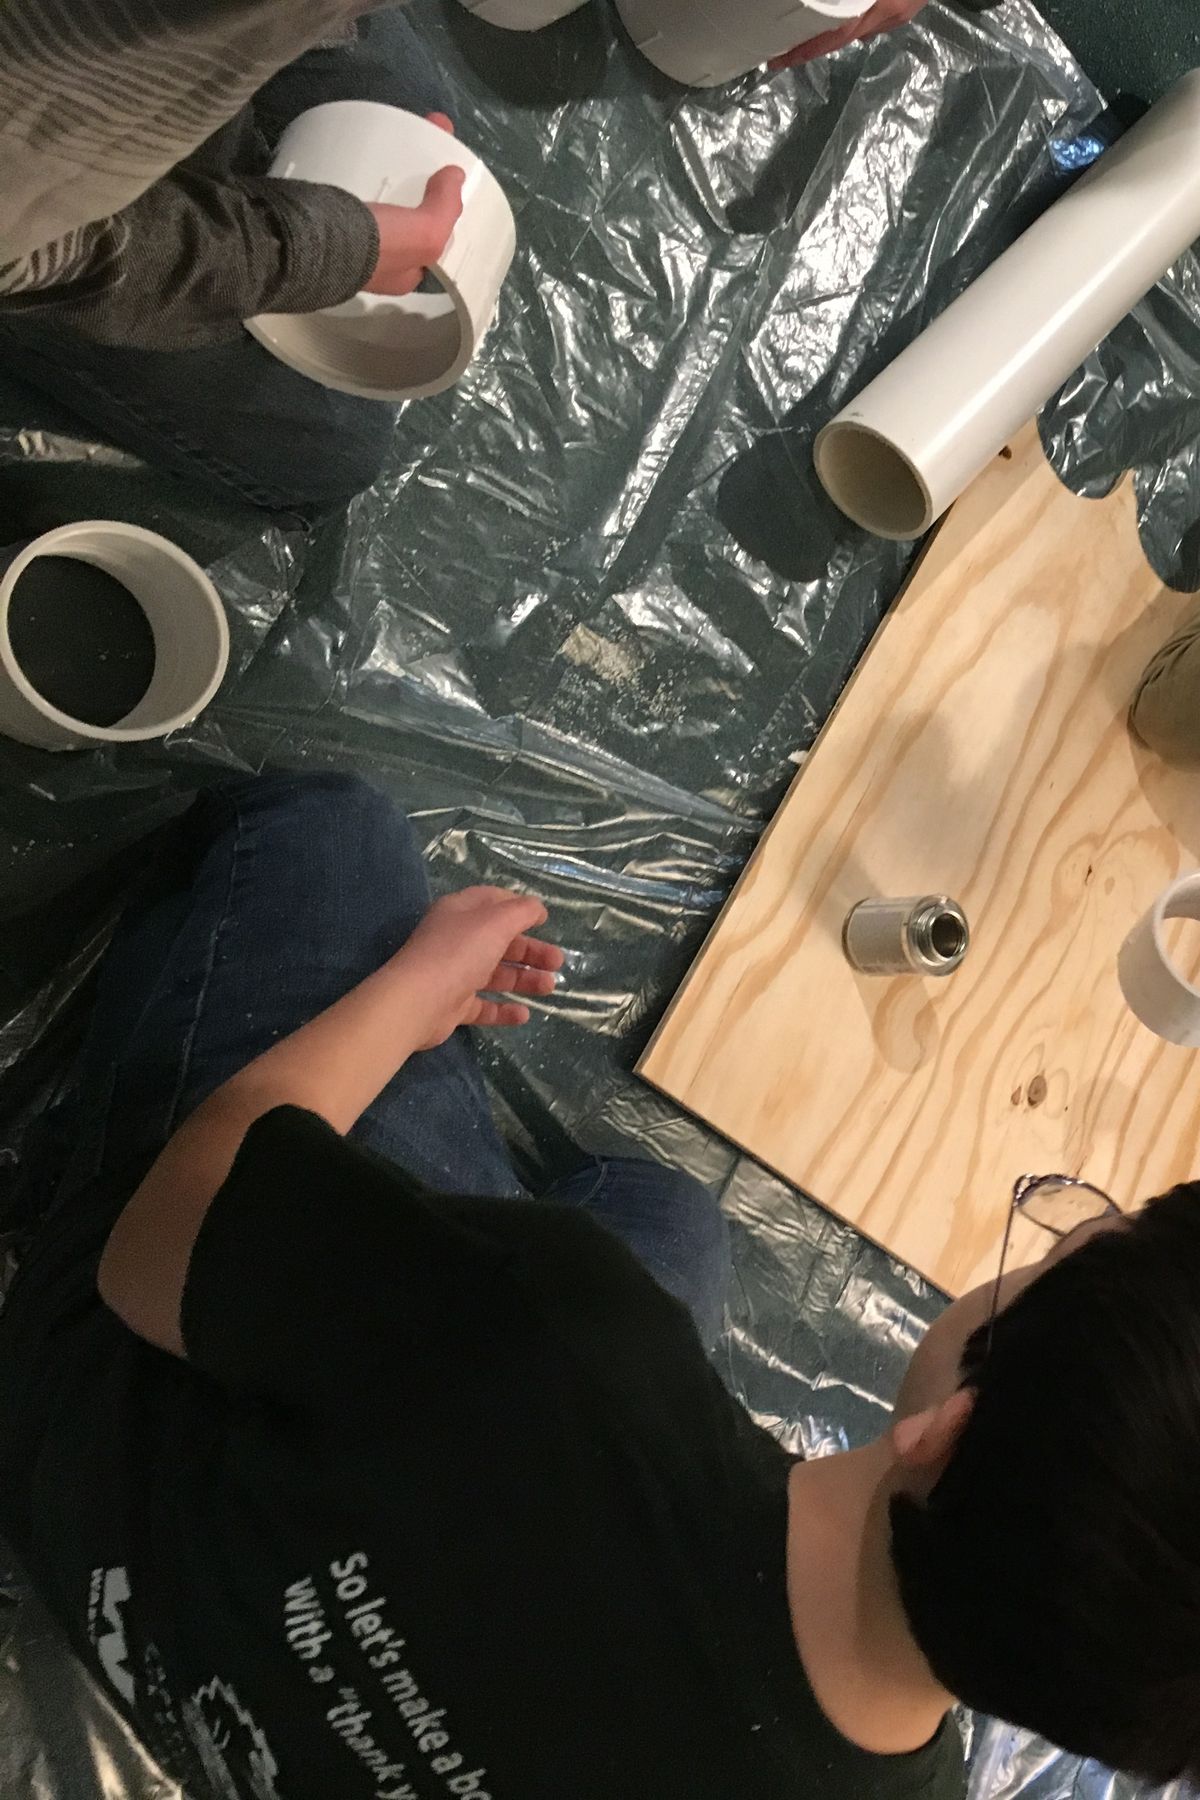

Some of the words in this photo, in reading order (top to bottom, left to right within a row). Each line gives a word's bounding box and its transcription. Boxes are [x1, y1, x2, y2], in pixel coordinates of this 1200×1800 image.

[330, 1552, 368, 1601] So
[345, 1597, 406, 1668] let's
[309, 1666, 334, 1683] a
[382, 1669, 450, 1753] make
[430, 1752, 463, 1774] a
